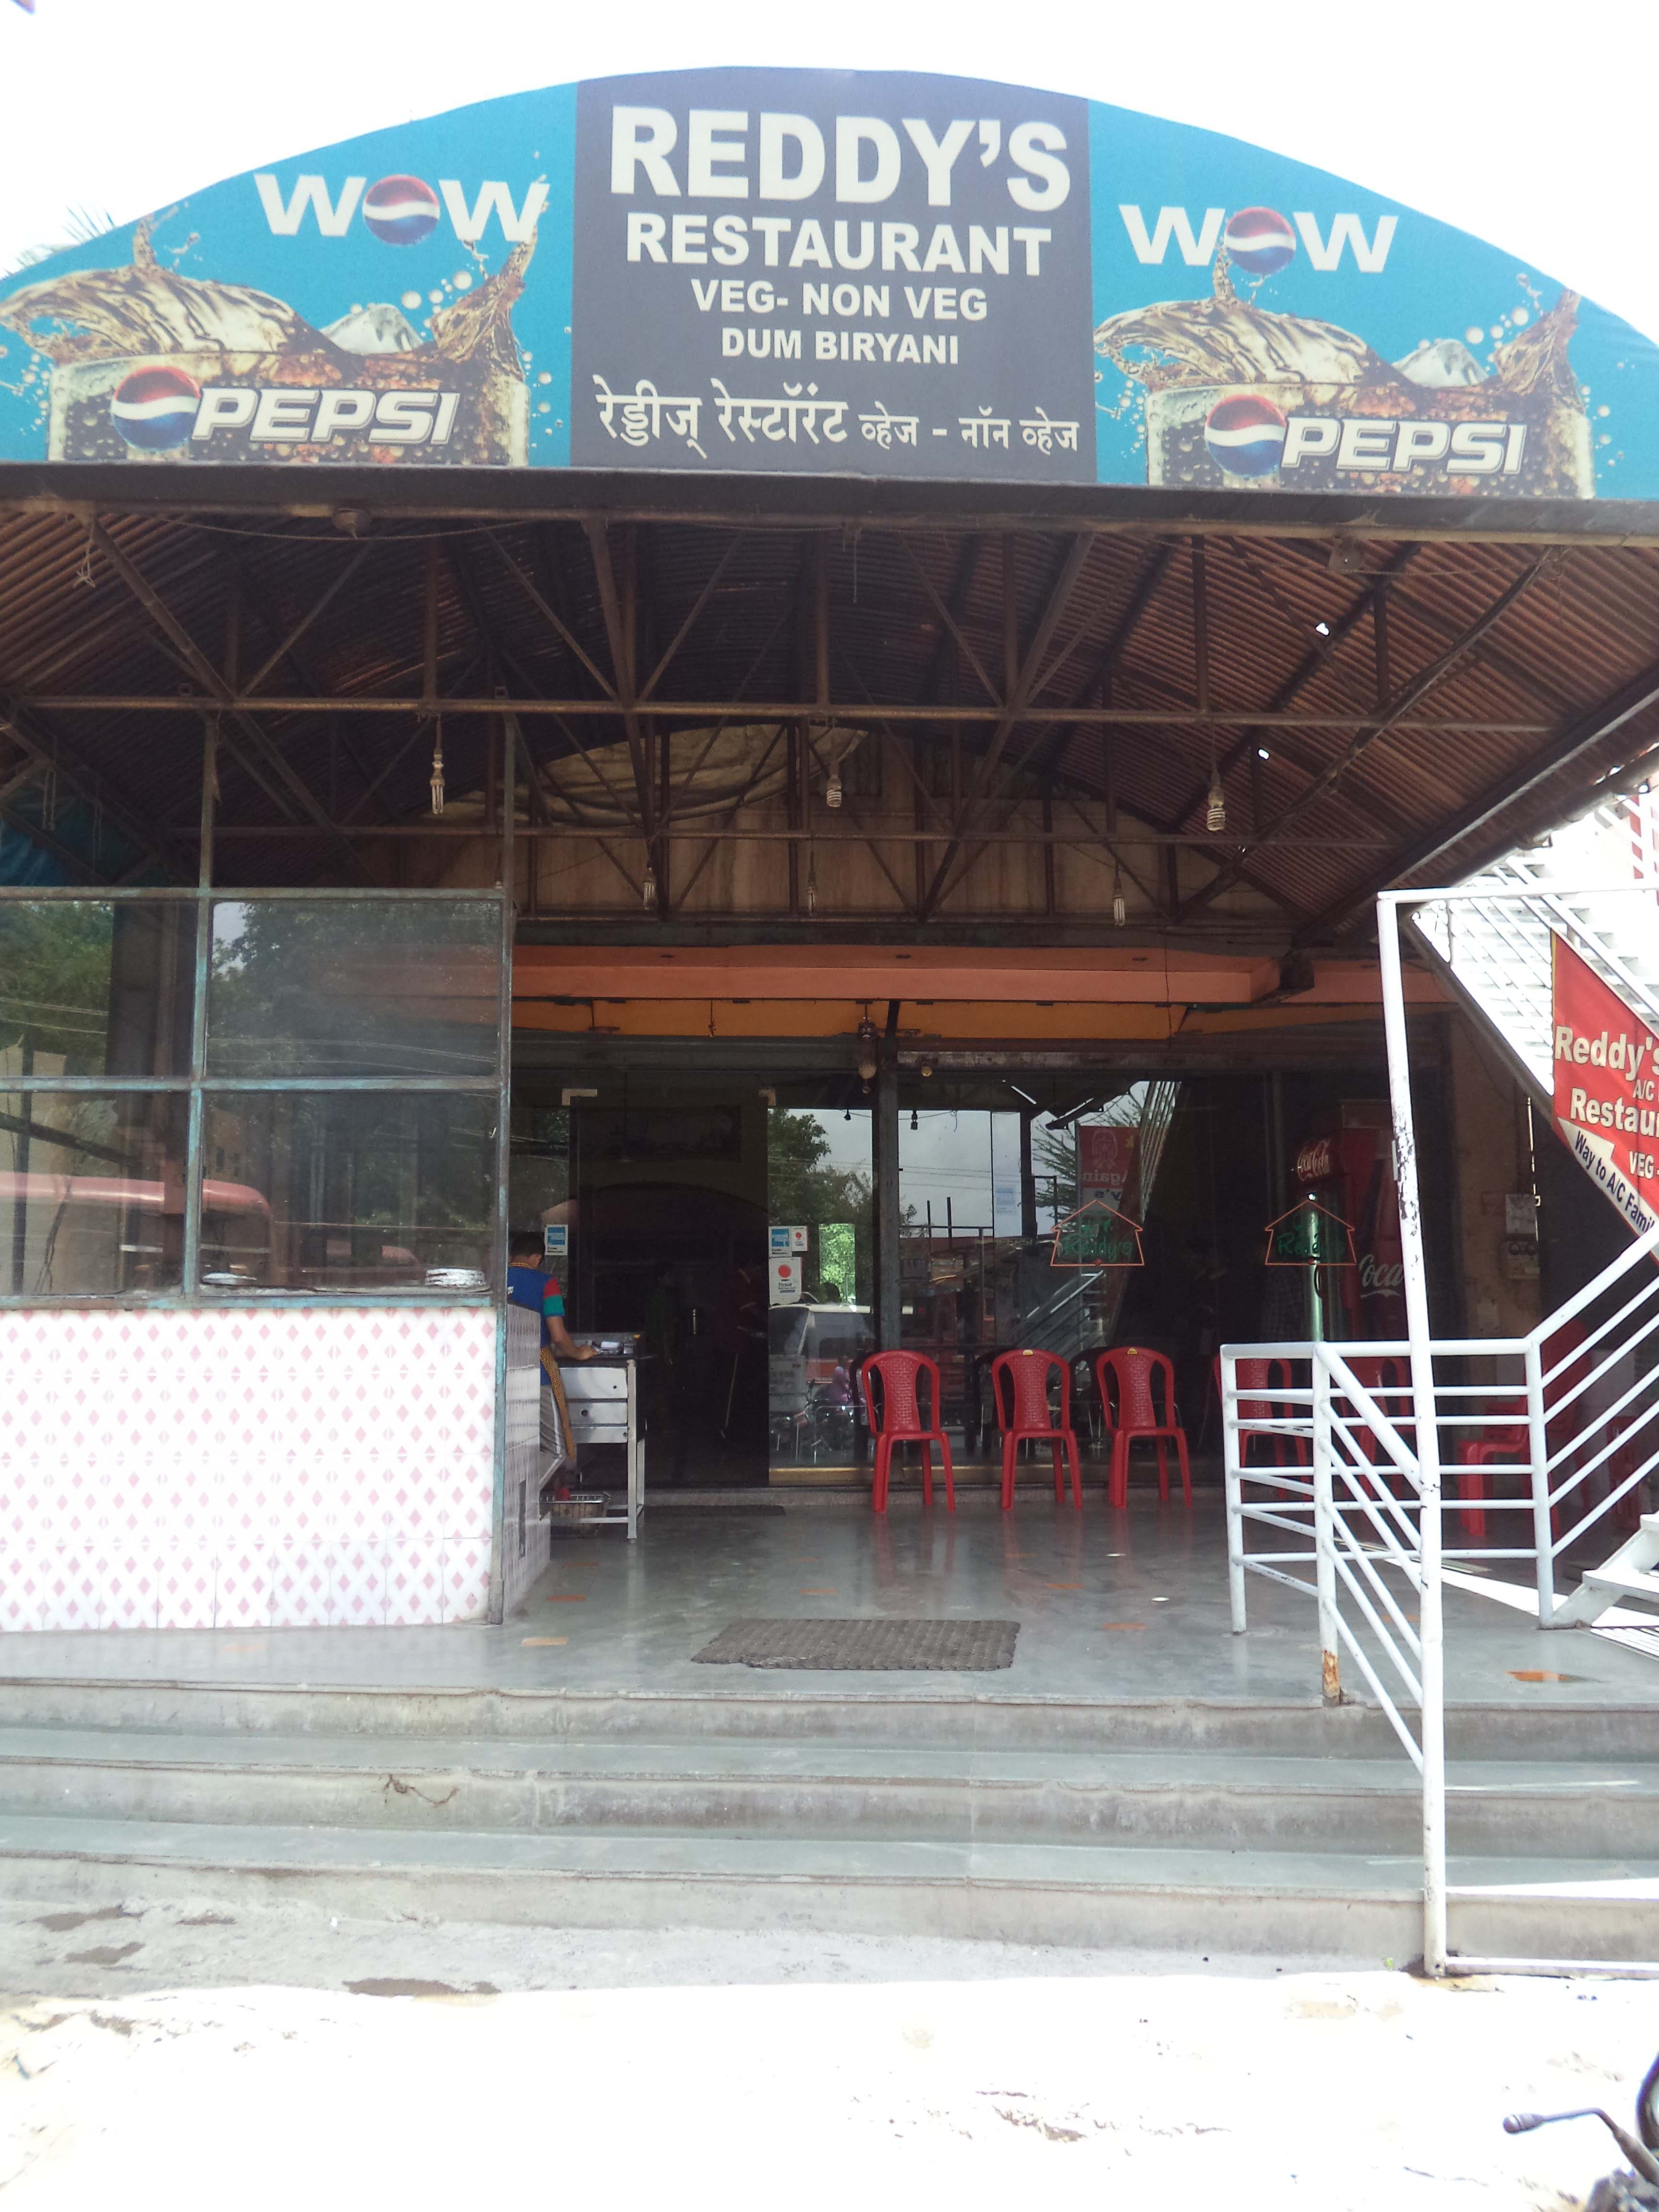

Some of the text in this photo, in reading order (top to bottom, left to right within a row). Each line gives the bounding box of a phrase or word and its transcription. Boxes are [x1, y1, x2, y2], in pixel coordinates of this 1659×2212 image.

[626, 212, 1052, 276] RESTAURANT
[802, 282, 890, 318] NON
[903, 286, 987, 321] VEG
[721, 327, 959, 365] DUM BIRYANI
[191, 387, 461, 445] PEPSI
[857, 400, 920, 450] व्हेज
[958, 405, 1011, 449] नॉन
[1018, 406, 1080, 456] व्हेज
[1280, 417, 1528, 475] PEPSI
[1570, 1087, 1659, 1137] Restau
[1633, 1079, 1655, 1101] A/C
[1575, 1130, 1595, 1170] Way
[1596, 1158, 1606, 1180] to
[1607, 1173, 1625, 1202] A/C
[1629, 1151, 1654, 1179] VEG
